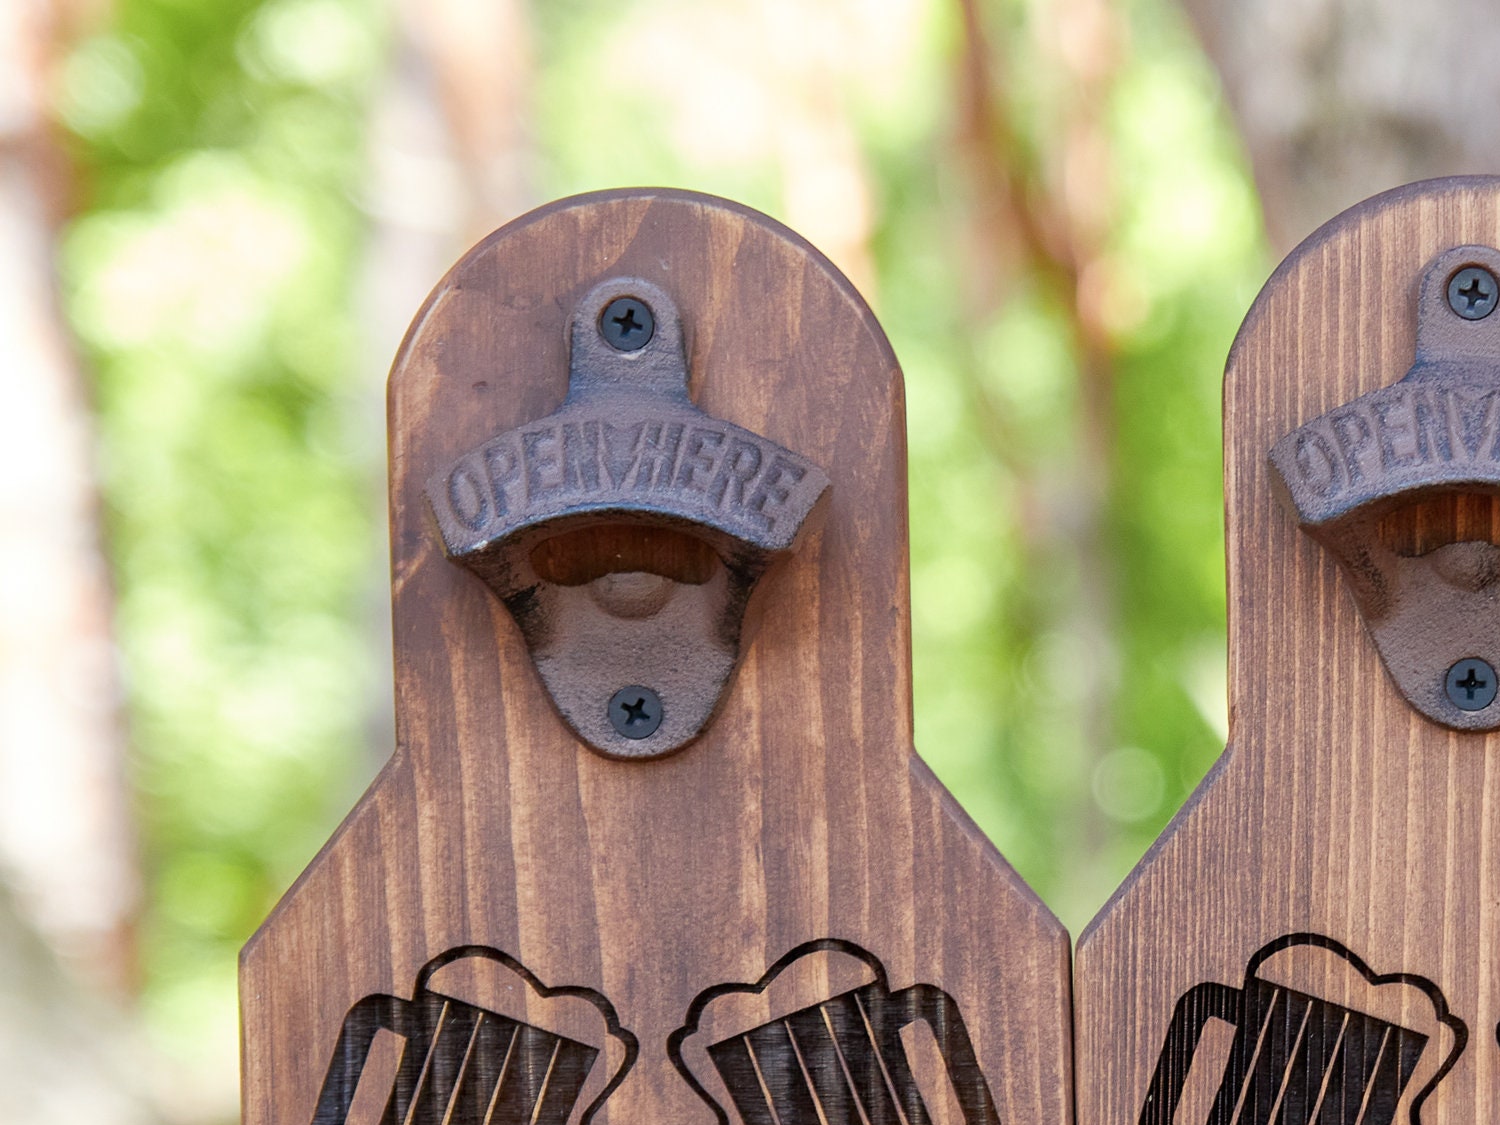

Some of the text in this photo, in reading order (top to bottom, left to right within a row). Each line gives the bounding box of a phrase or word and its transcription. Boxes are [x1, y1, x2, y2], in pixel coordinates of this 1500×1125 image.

[446, 420, 807, 533] OPEN HERE
[1297, 390, 1453, 497] OPEN
